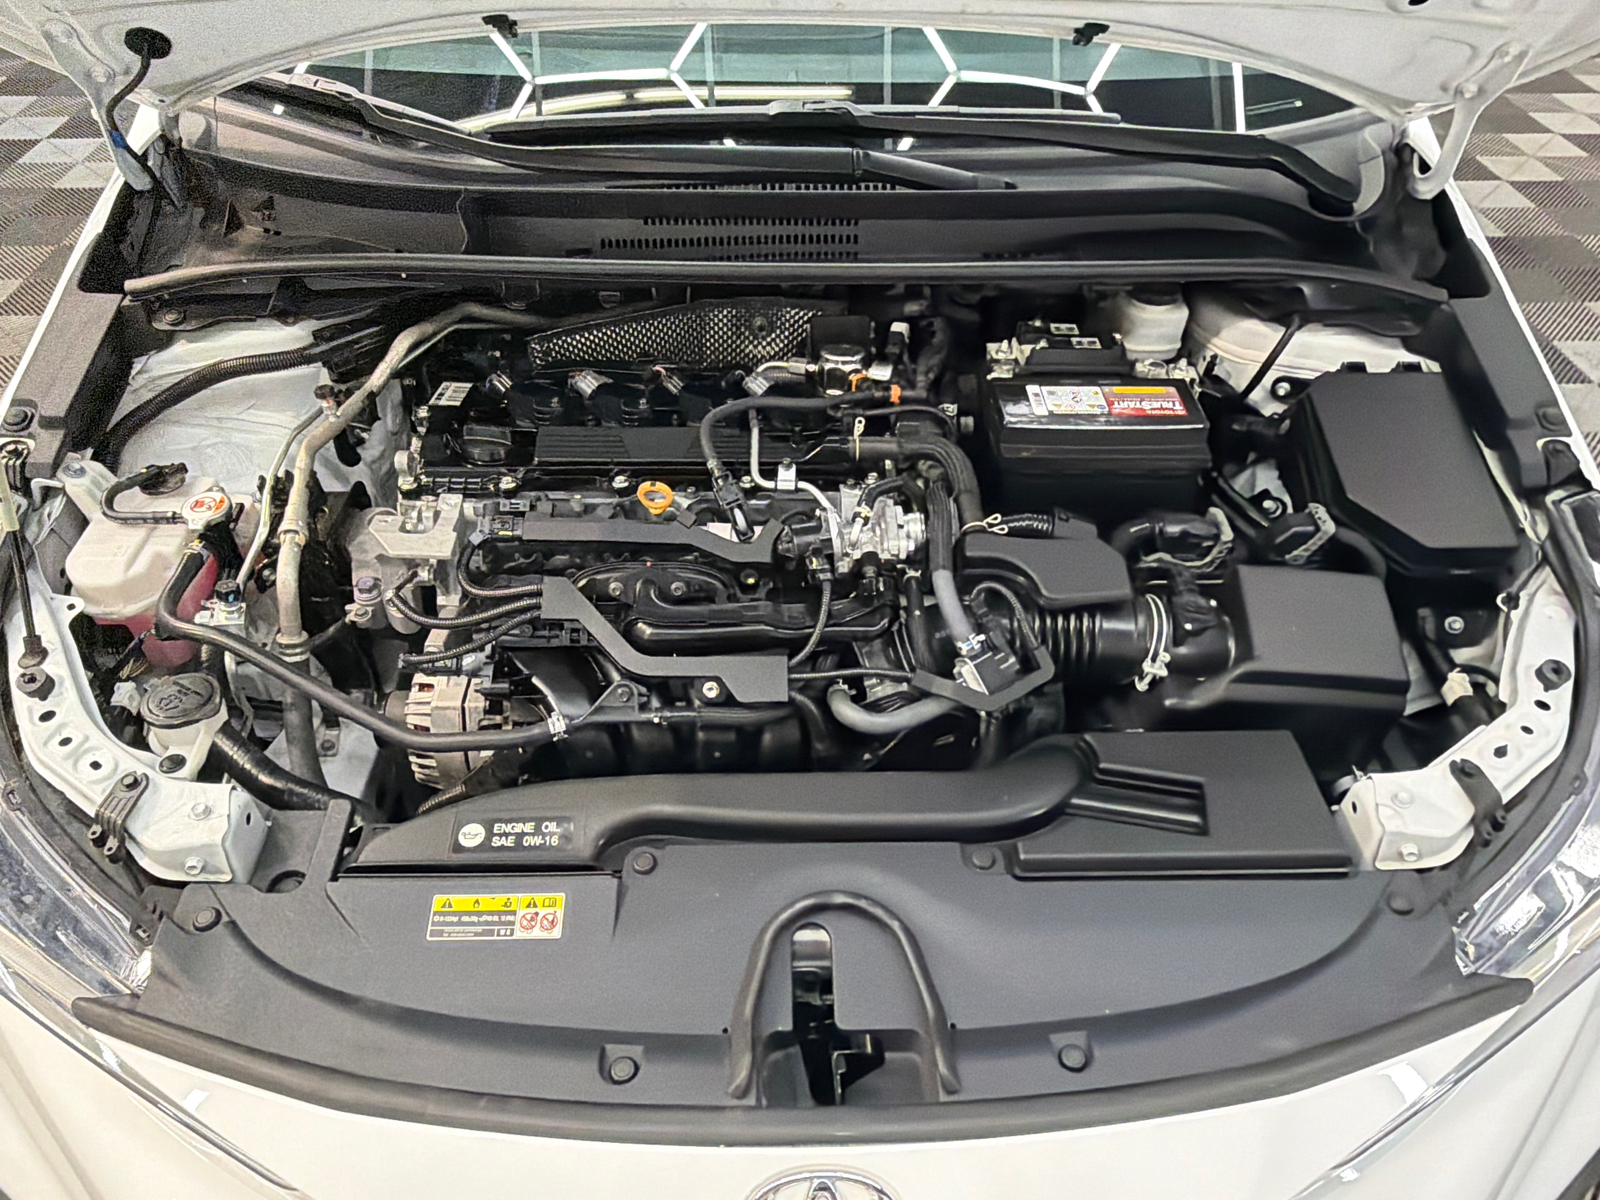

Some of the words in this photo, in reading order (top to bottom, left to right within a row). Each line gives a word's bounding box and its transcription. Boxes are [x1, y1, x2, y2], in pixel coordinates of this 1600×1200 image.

[493, 822, 535, 833] ENGINE
[541, 822, 560, 833] OIL
[491, 836, 515, 847] SAE
[522, 835, 559, 847] 0W-16
